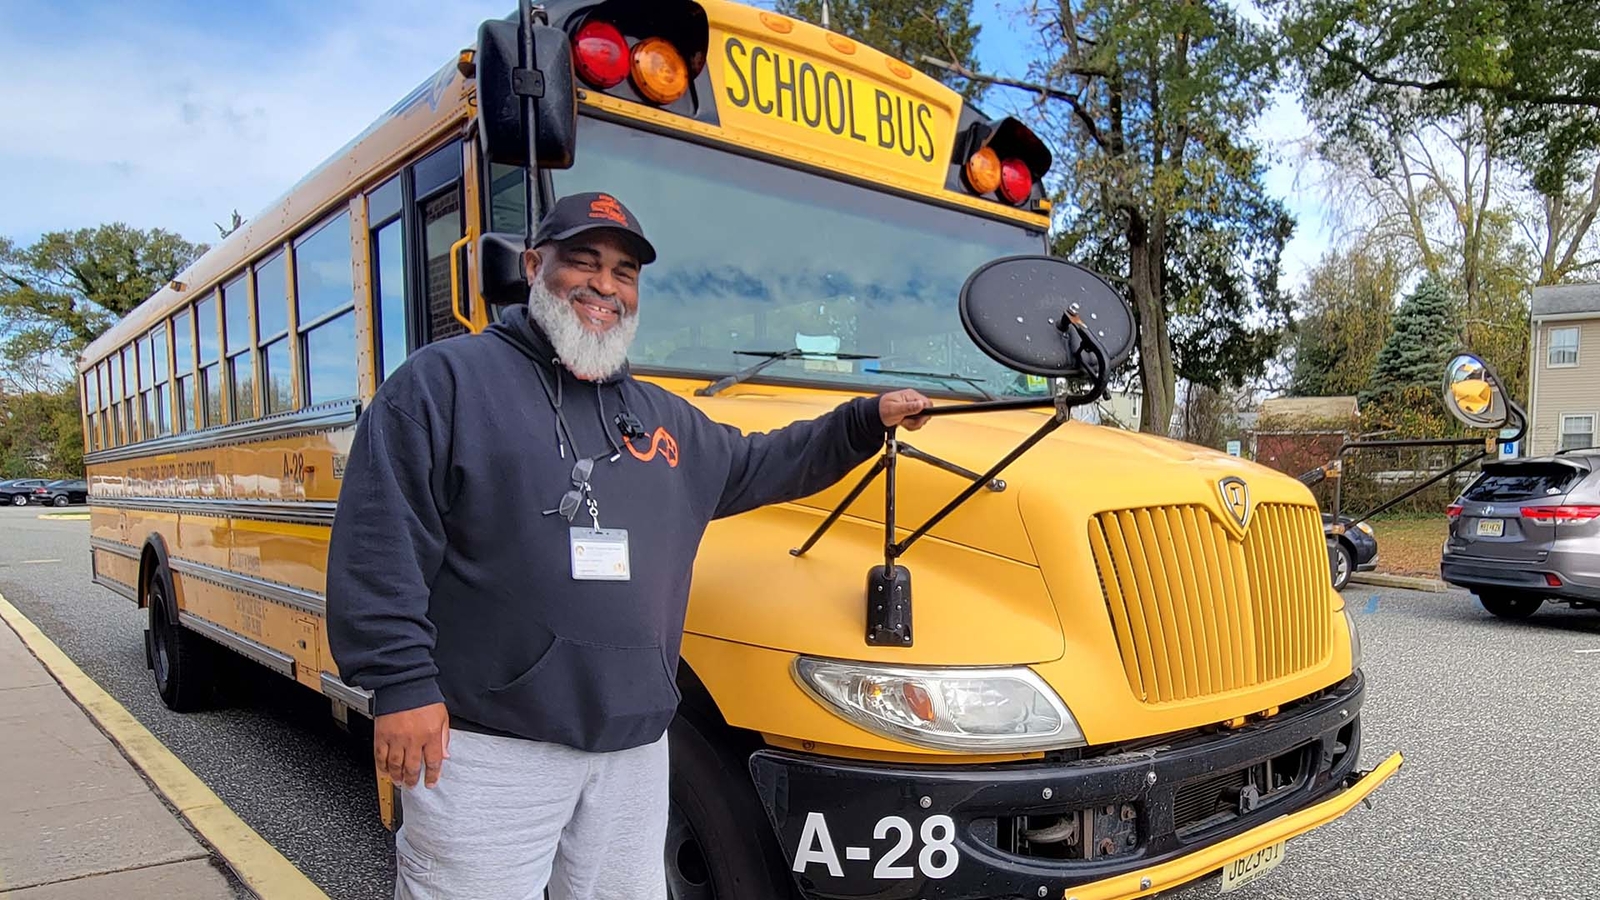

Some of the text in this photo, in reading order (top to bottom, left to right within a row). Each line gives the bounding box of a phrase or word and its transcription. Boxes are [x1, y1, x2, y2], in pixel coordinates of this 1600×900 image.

[725, 37, 935, 163] SCHOOL BUS
[283, 452, 304, 483] A-28
[792, 812, 960, 879] A-28
